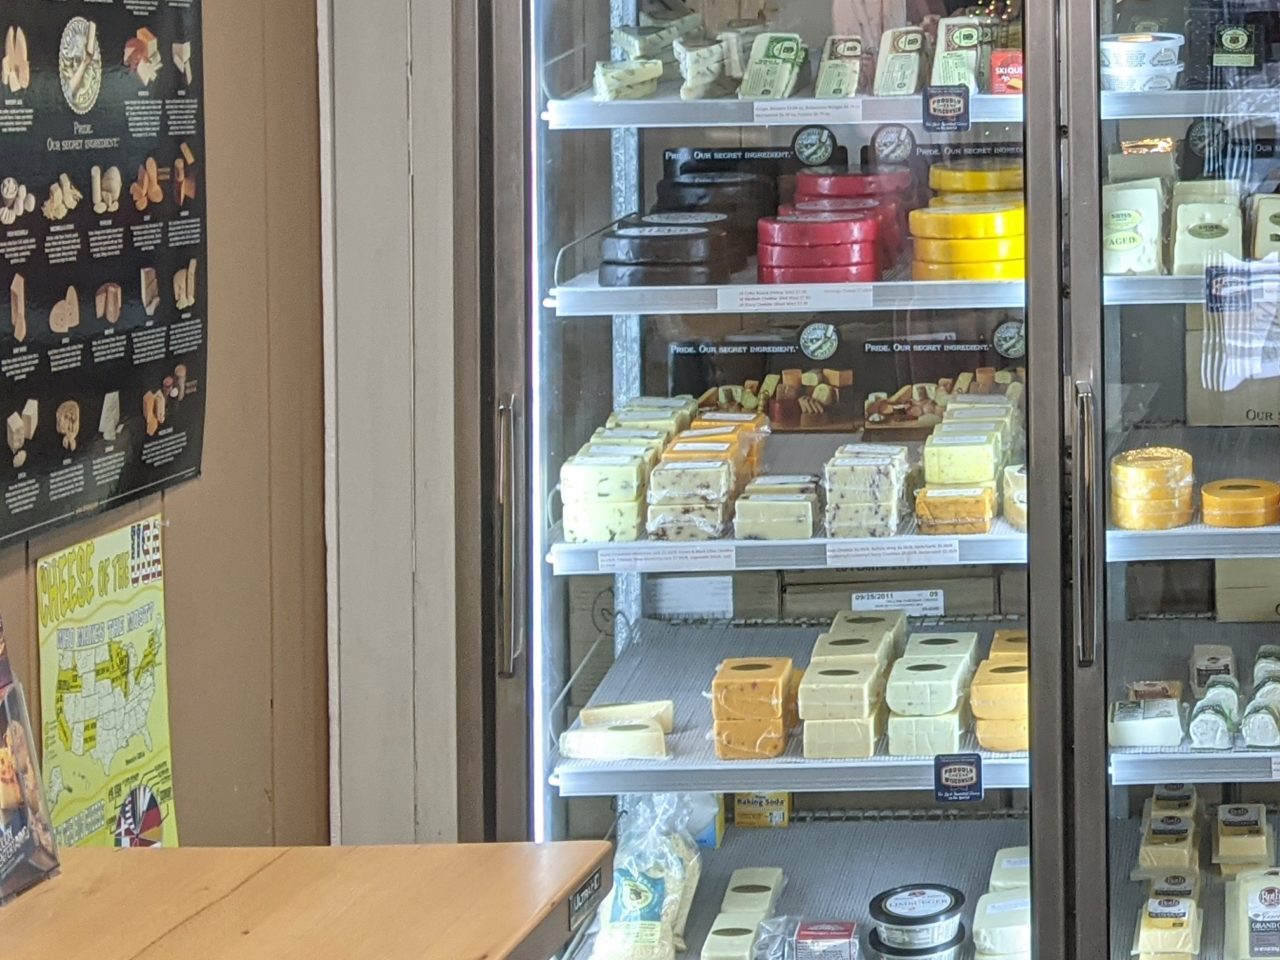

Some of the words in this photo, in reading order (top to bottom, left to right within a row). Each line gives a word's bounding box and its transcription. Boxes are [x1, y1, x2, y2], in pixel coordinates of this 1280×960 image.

[1108, 235, 1136, 246] AGED
[1245, 408, 1273, 421] OUR
[38, 540, 95, 629] CHEESE
[854, 592, 894, 601] 09/25/2011
[737, 798, 763, 807] Baking
[765, 797, 784, 806] Soda
[1251, 922, 1276, 930] GRAND
